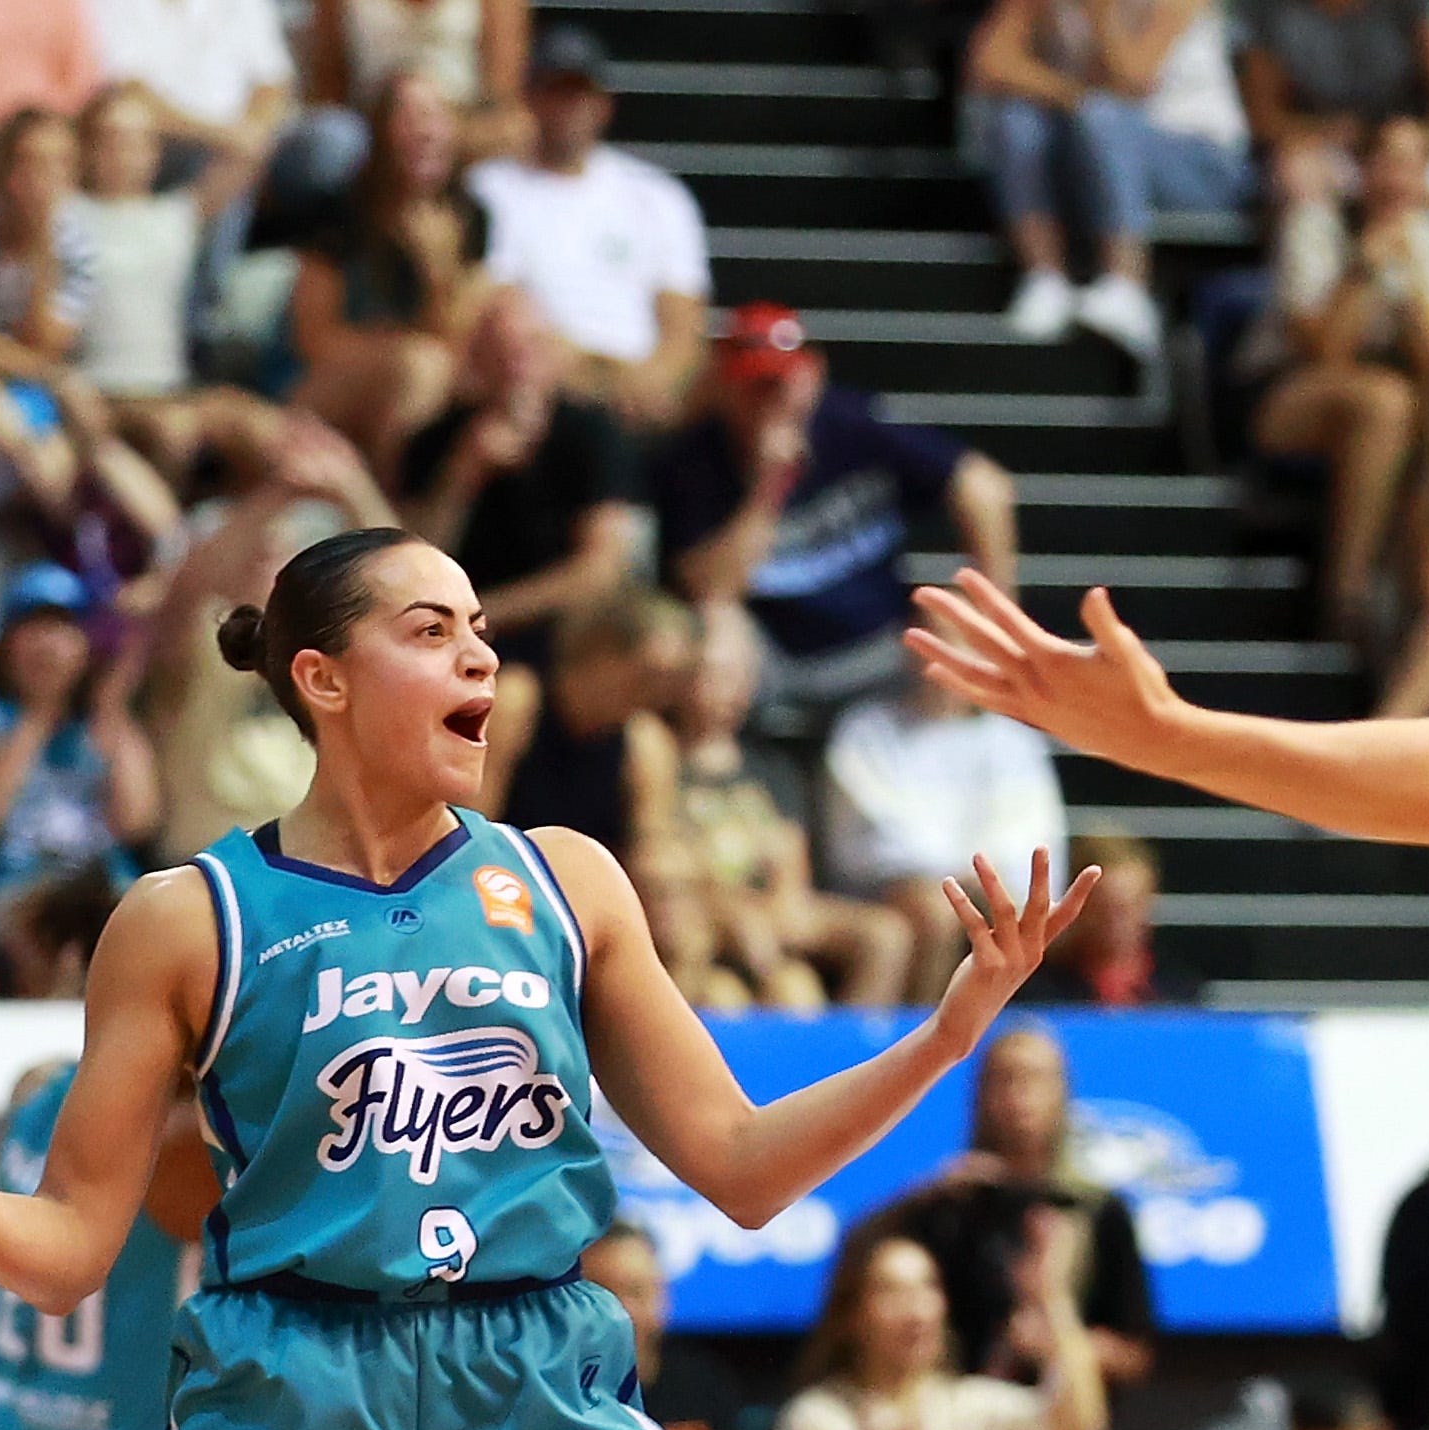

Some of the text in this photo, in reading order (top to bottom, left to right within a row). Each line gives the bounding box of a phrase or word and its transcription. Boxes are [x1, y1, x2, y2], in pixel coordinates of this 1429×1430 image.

[303, 966, 550, 1033] Jayco
[323, 1043, 567, 1177] Flyers
[418, 1206, 479, 1283] 9
